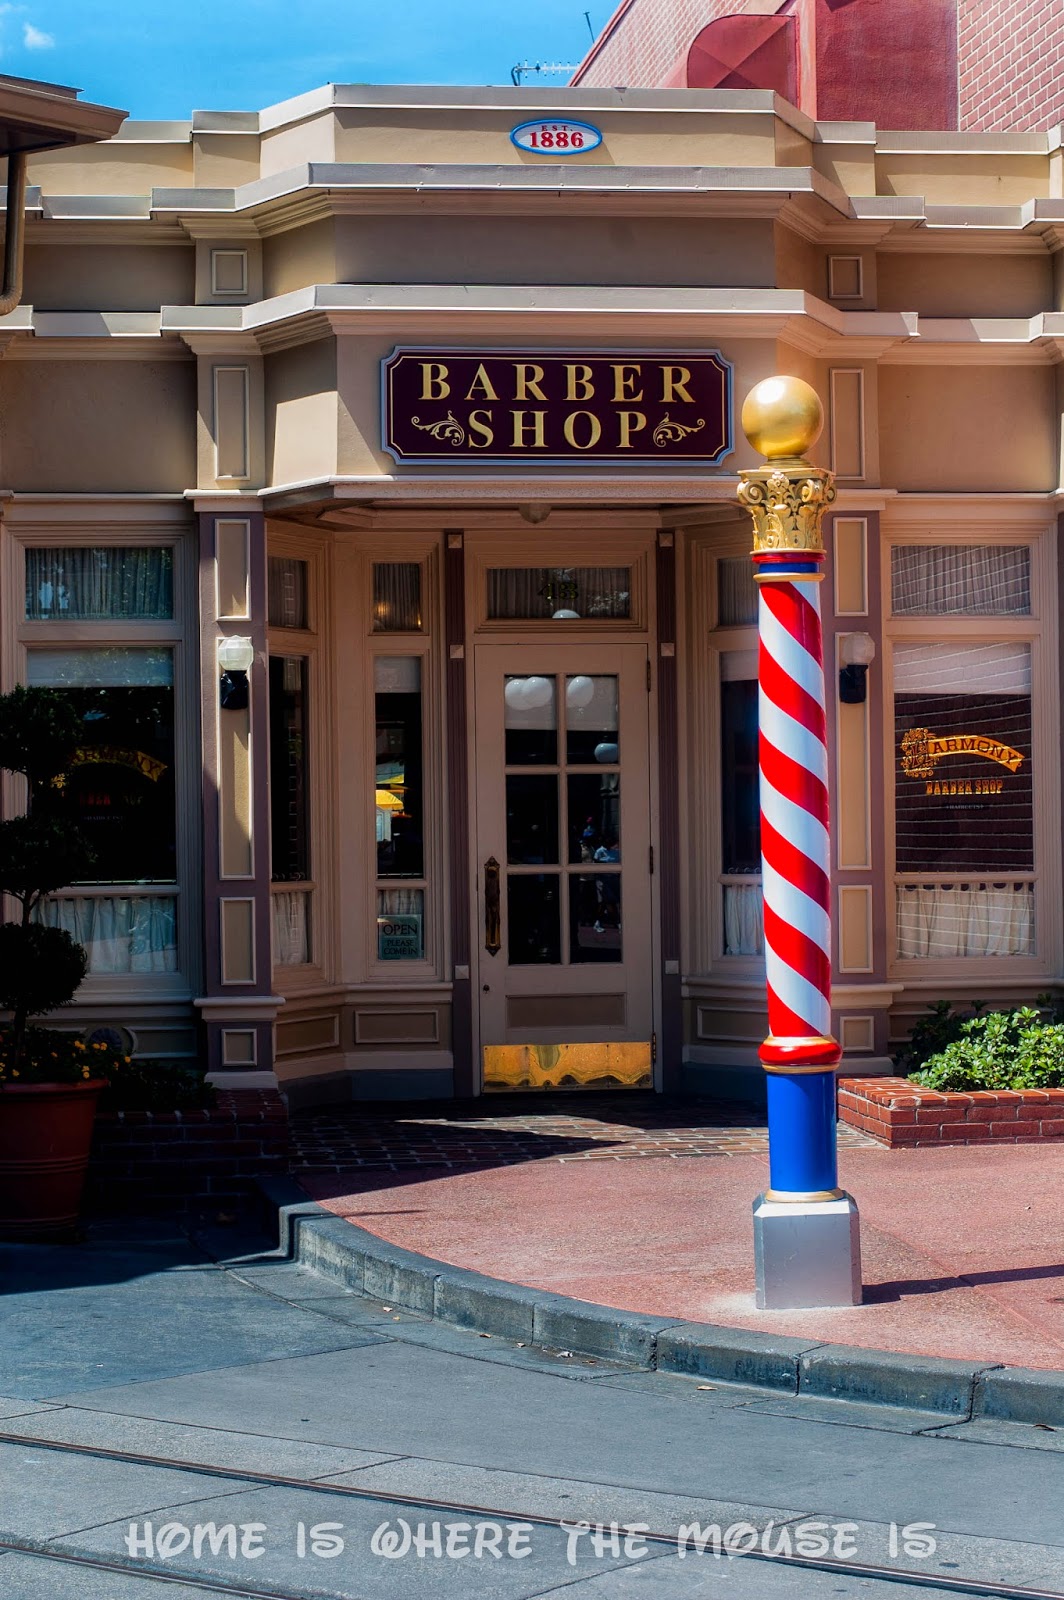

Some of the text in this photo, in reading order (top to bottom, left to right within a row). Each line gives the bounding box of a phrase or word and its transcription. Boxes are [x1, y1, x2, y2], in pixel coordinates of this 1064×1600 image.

[529, 131, 585, 149] 1886
[417, 362, 697, 403] BARBER
[467, 409, 648, 450] SHOP
[926, 778, 1003, 795] BARBER SHOP
[383, 924, 418, 936] OPEN
[383, 947, 418, 955] COME IN
[386, 939, 415, 947] PLEASE
